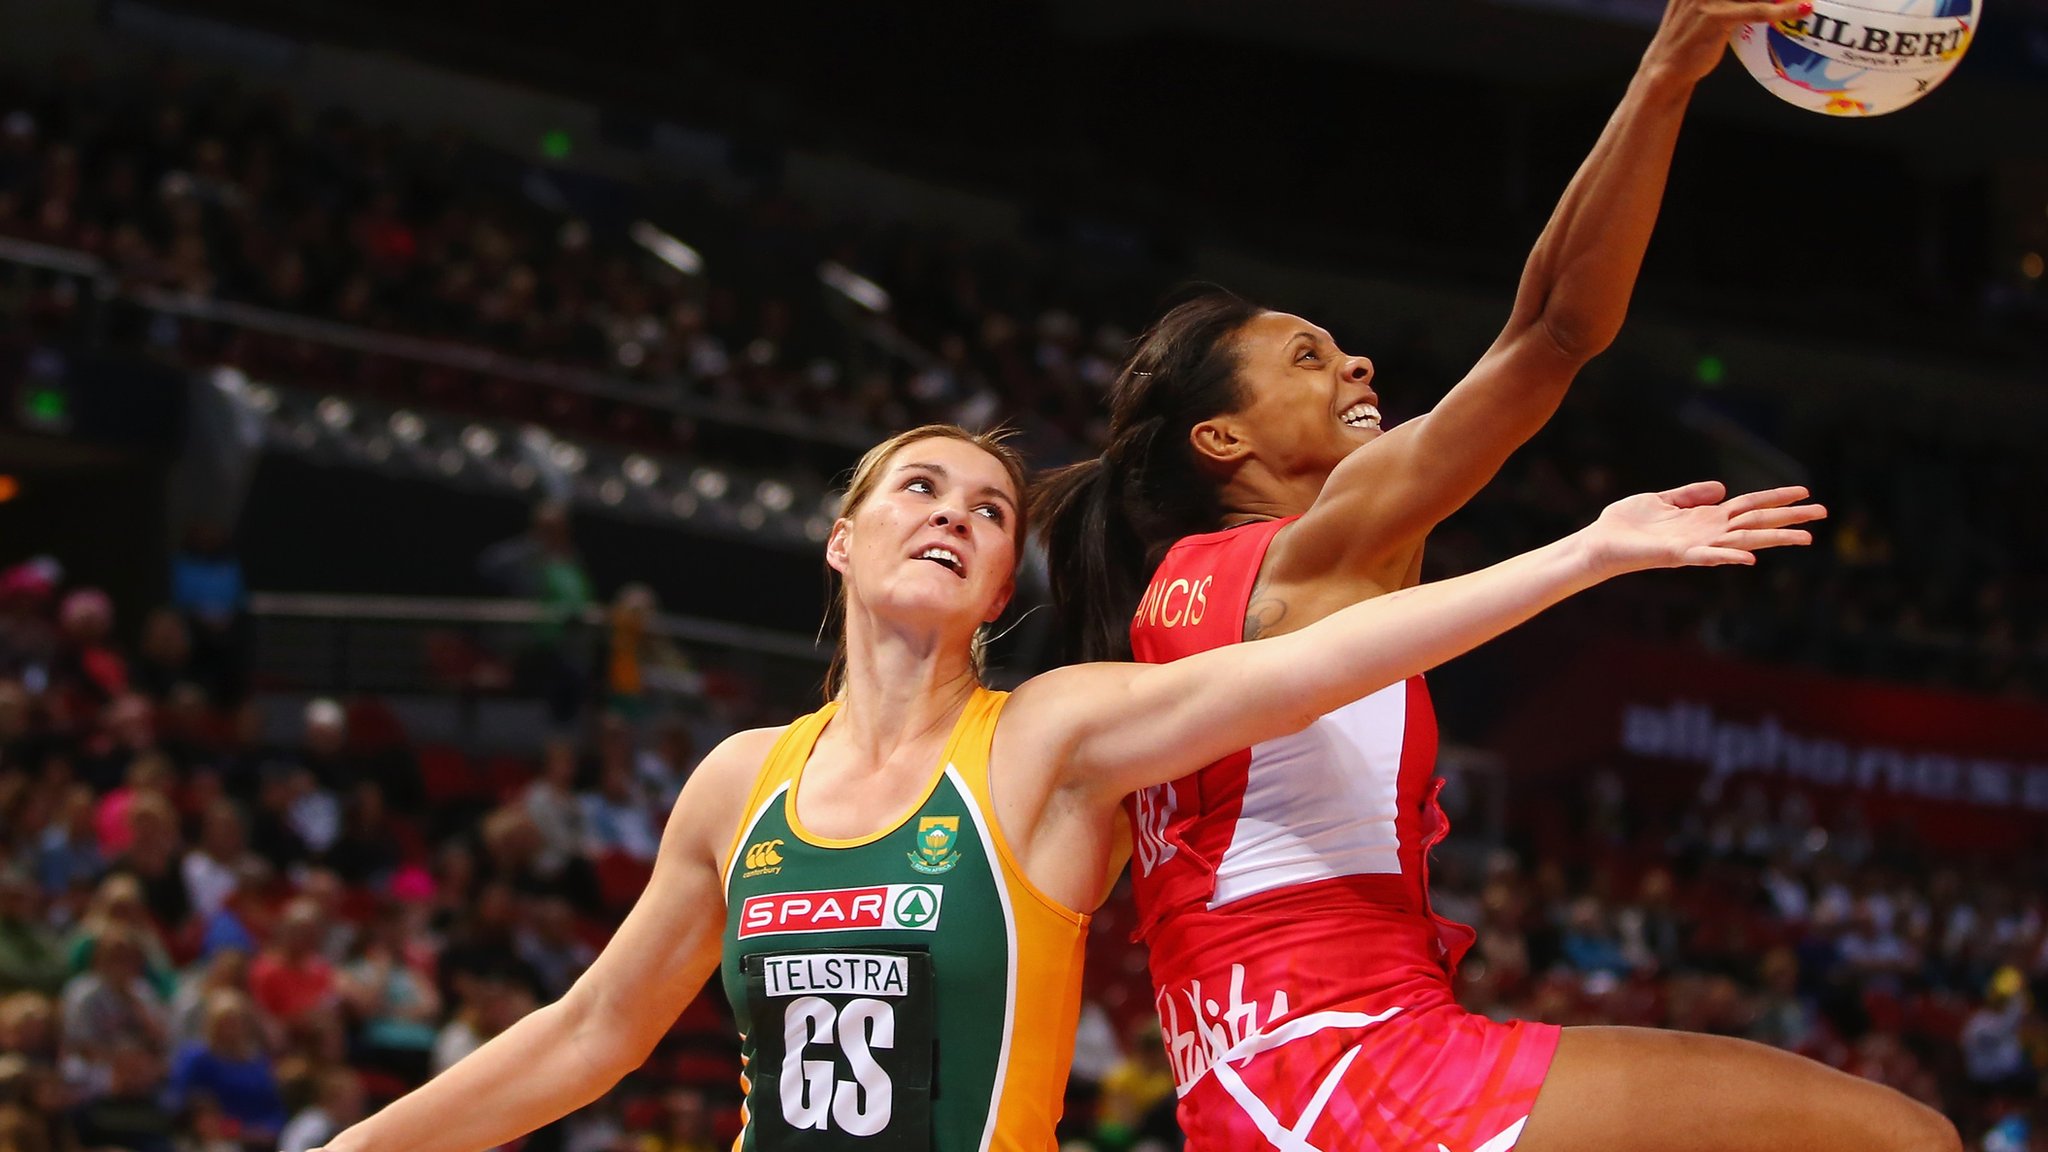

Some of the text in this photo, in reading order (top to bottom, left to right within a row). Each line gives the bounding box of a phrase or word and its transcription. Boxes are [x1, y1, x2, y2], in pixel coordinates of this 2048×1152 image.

[743, 866, 782, 879] canterbury
[746, 893, 883, 929] SPAR
[766, 958, 904, 992] TELSTRA
[779, 996, 895, 1136] GS
